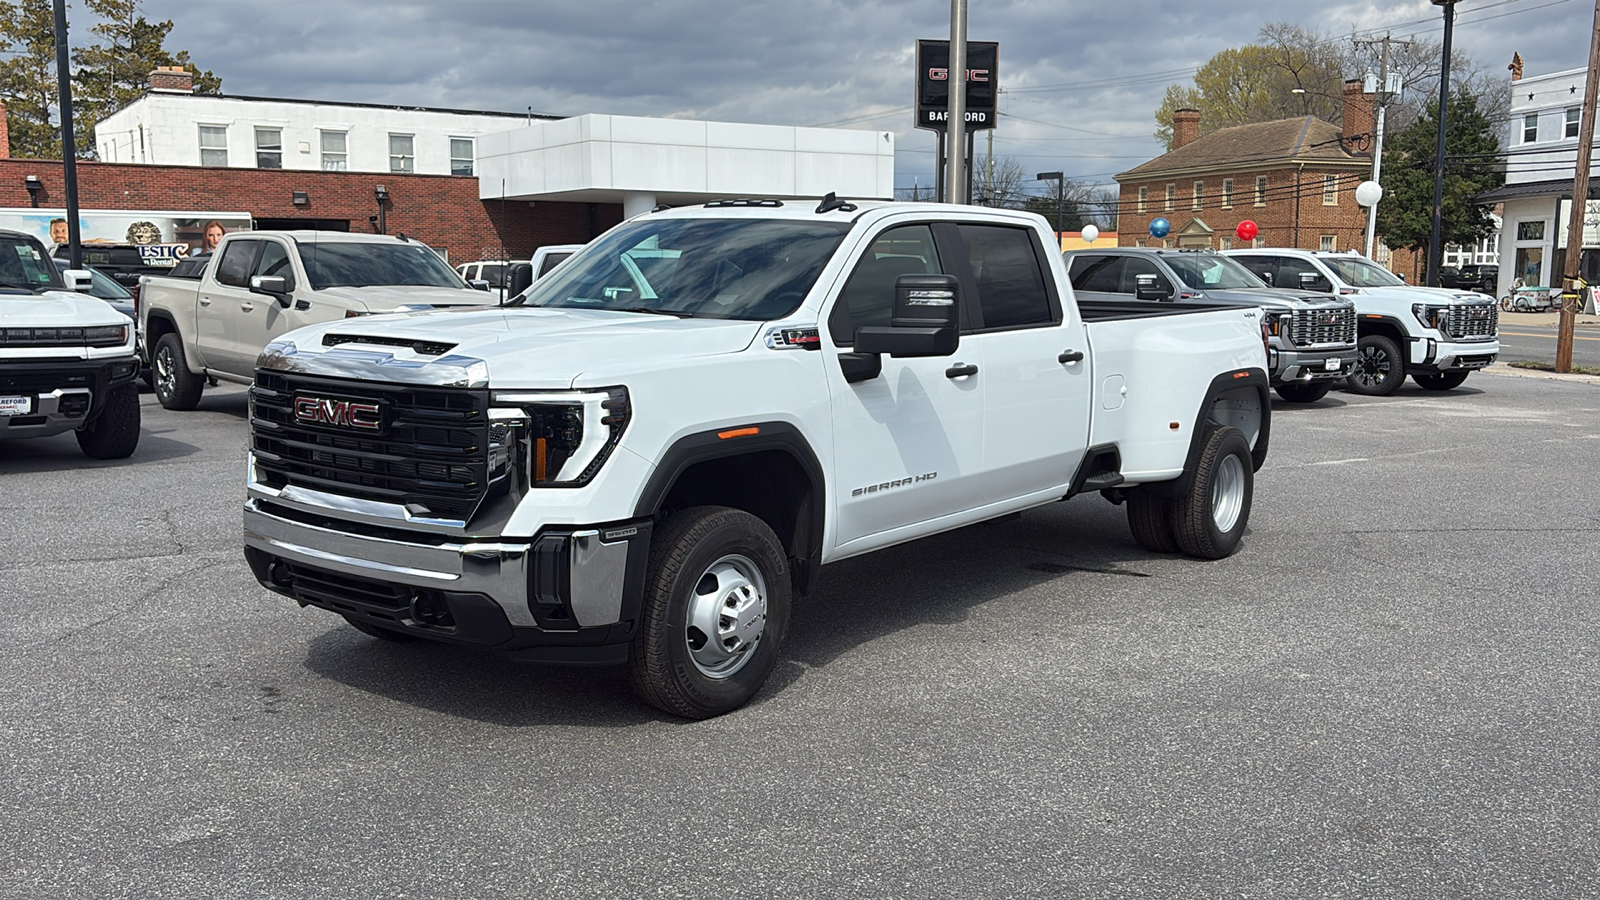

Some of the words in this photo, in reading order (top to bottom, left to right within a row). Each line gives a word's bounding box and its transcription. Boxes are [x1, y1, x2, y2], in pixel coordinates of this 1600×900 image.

[929, 111, 986, 122] BARORD
[138, 245, 187, 260] ESTIC
[295, 396, 379, 429] GMC
[851, 477, 913, 497] SIERRA
[915, 472, 938, 483] HD
